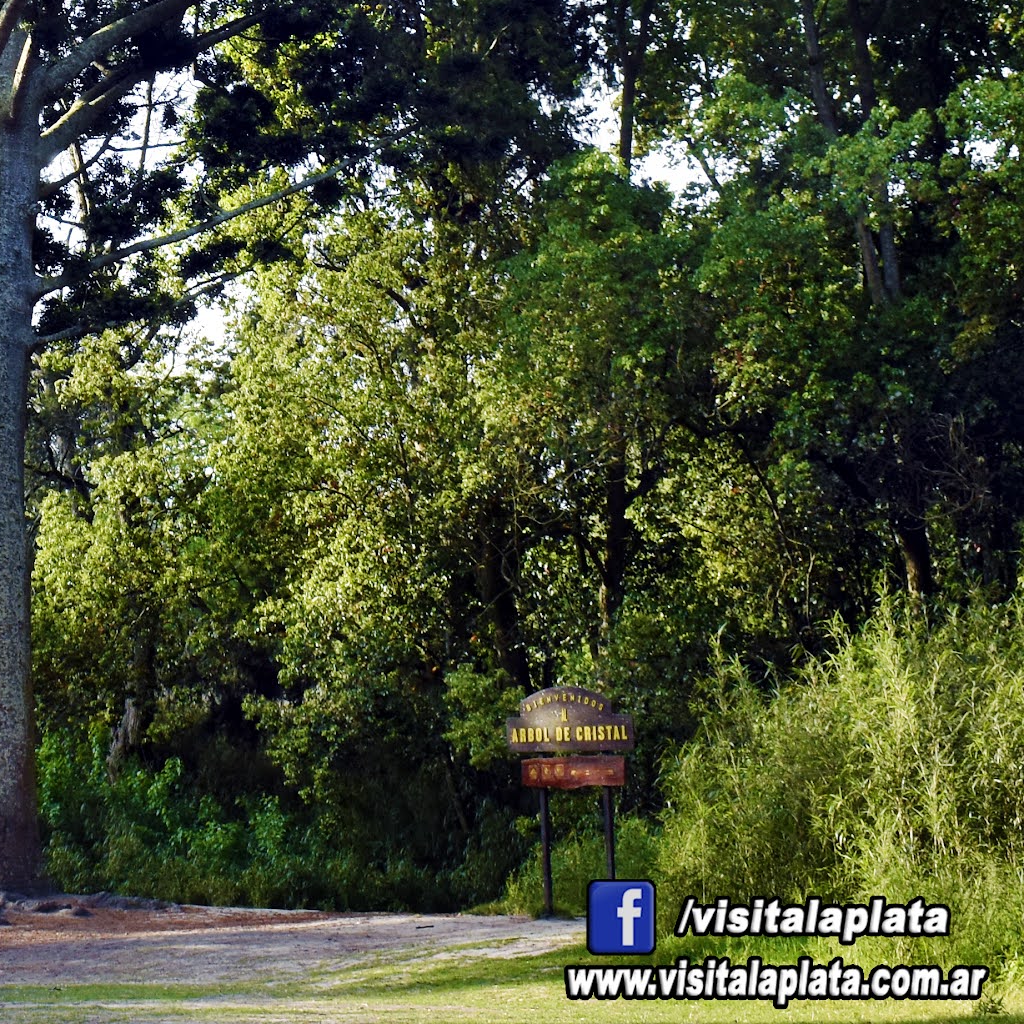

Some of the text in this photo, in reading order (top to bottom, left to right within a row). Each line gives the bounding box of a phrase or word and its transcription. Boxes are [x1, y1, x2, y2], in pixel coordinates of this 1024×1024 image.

[525, 693, 604, 712] BIENVENIDOS
[511, 725, 628, 743] ARBOL DE CRISTAL
